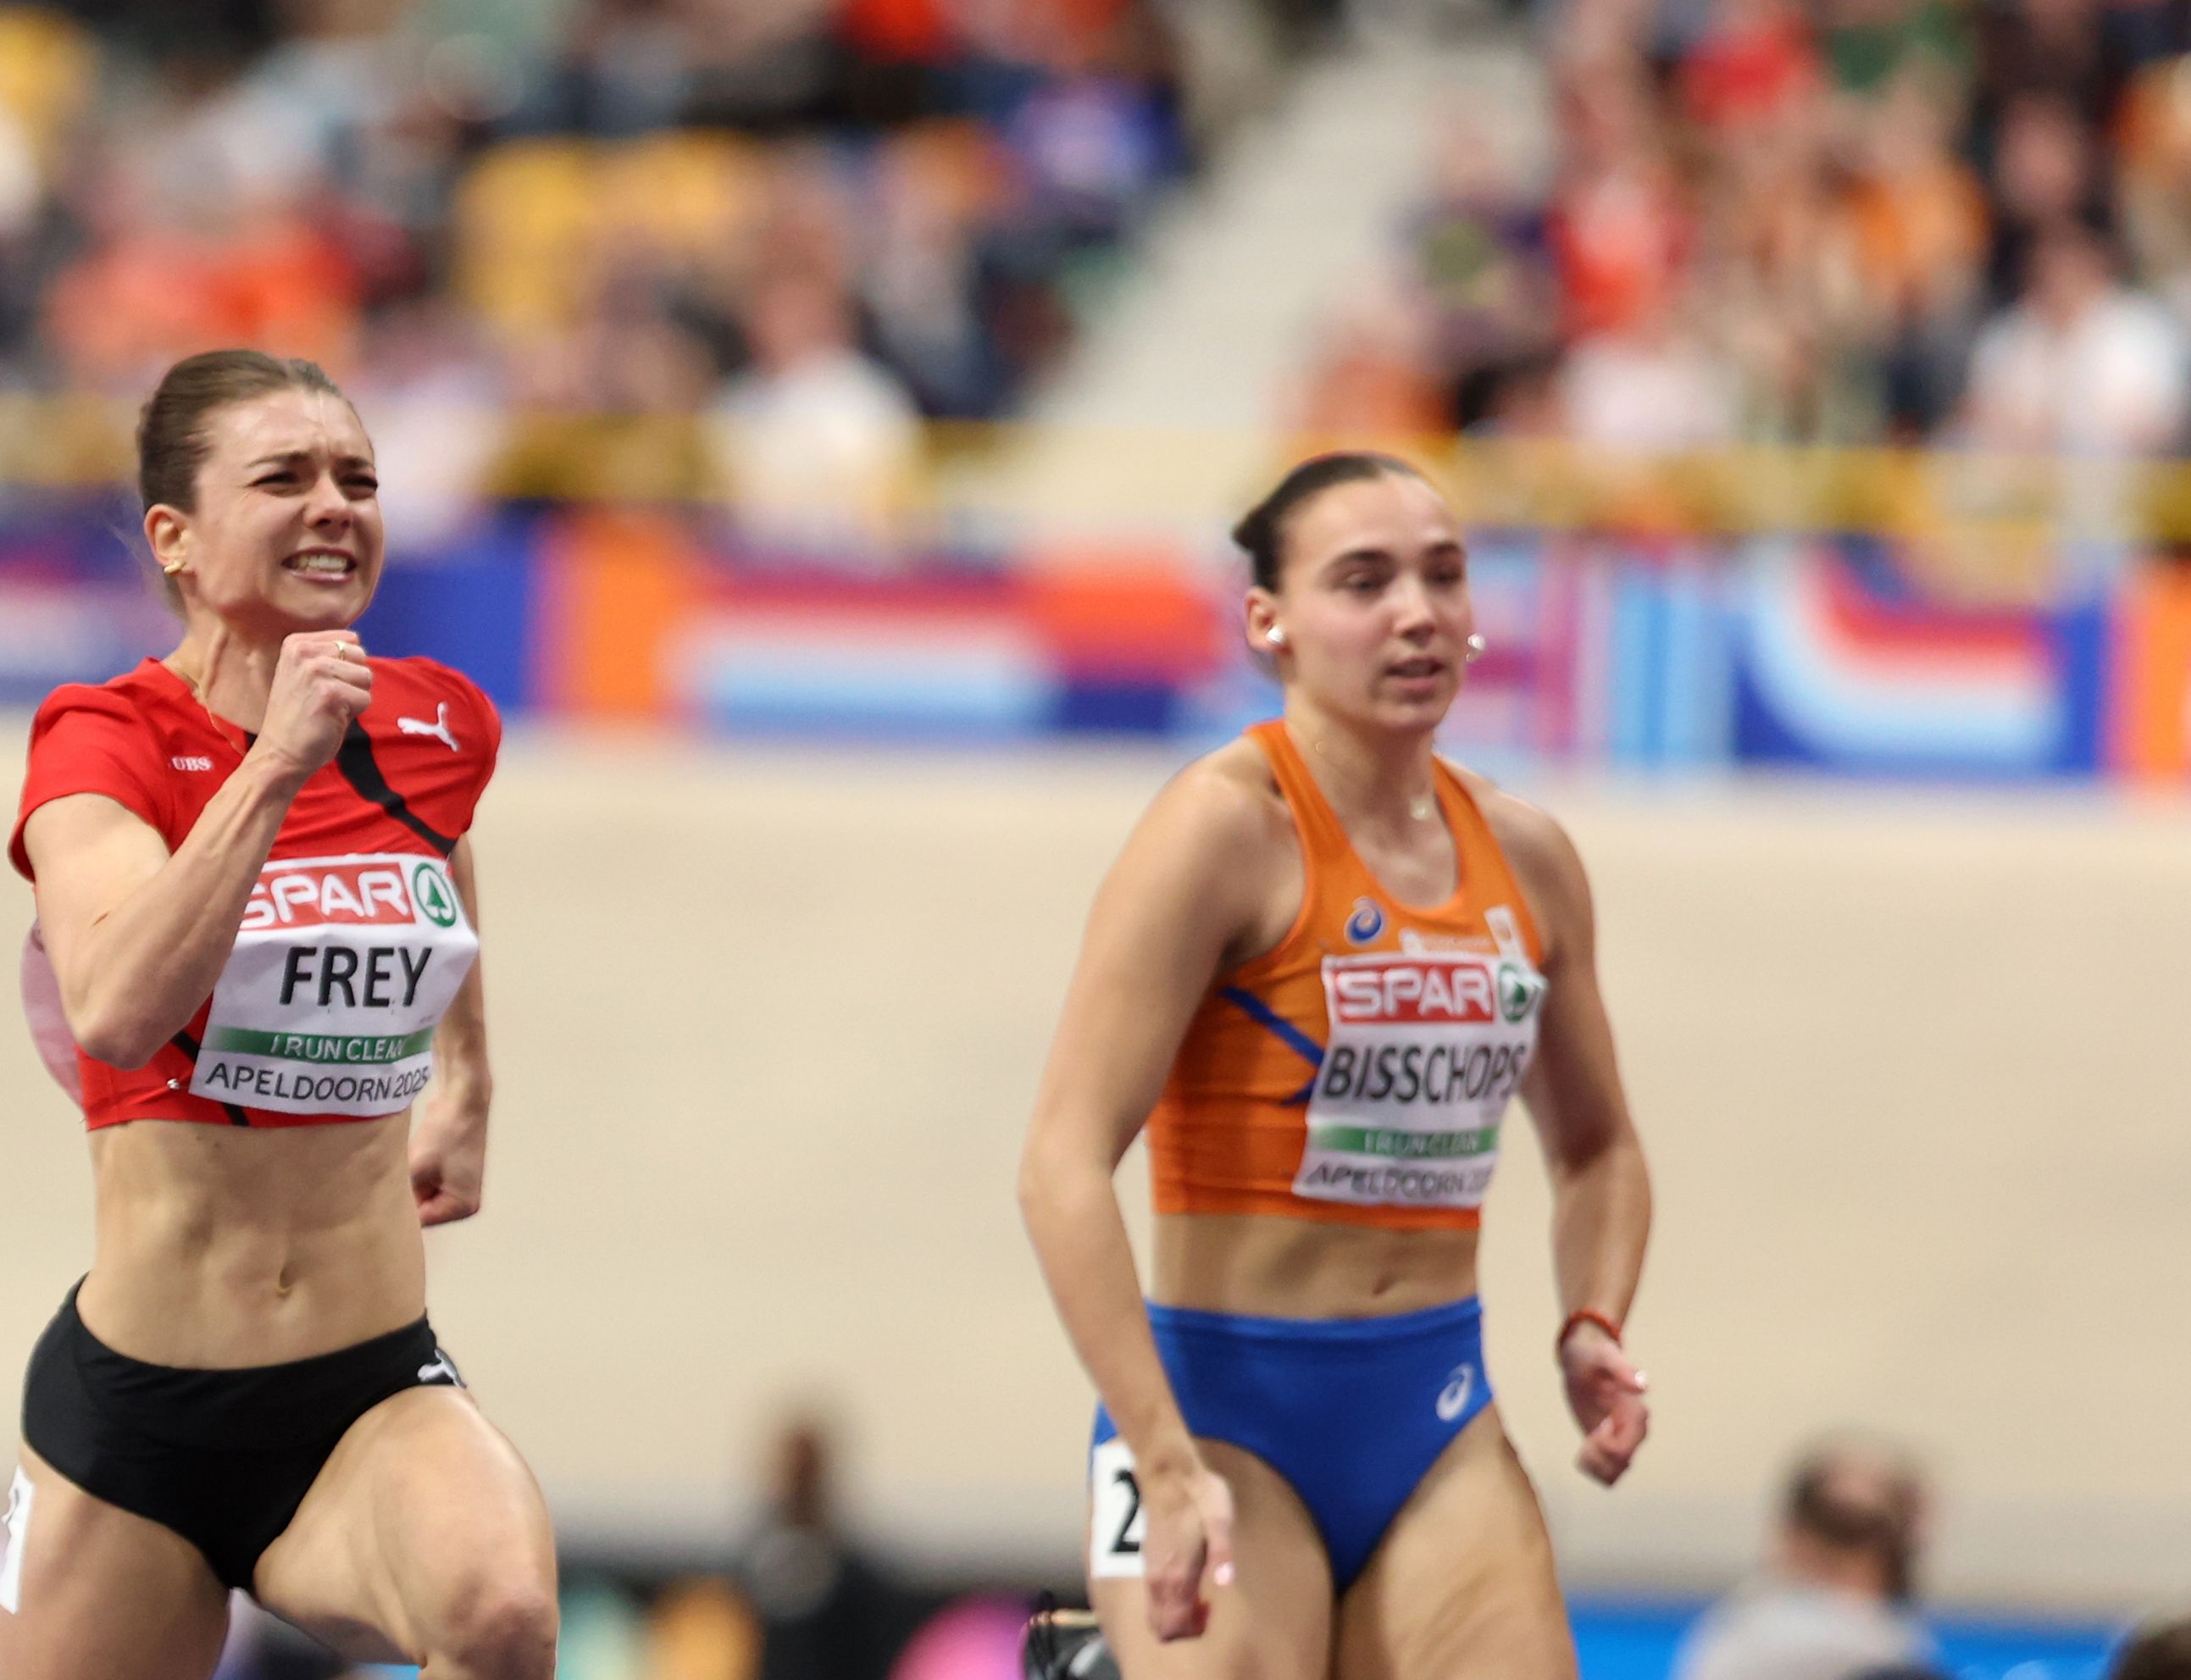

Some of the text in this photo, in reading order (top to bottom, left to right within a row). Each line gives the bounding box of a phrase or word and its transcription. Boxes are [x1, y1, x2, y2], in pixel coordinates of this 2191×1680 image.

[171, 757, 213, 772] UBS
[279, 945, 432, 1008] FREY
[1336, 968, 1493, 1017] SPAR
[270, 1034, 280, 1054] I
[284, 1036, 340, 1060] RUN
[205, 1062, 429, 1102] APELDOORN 2025
[1322, 1043, 1526, 1104] BISSCHOPS
[1110, 1468, 1140, 1552] 2
